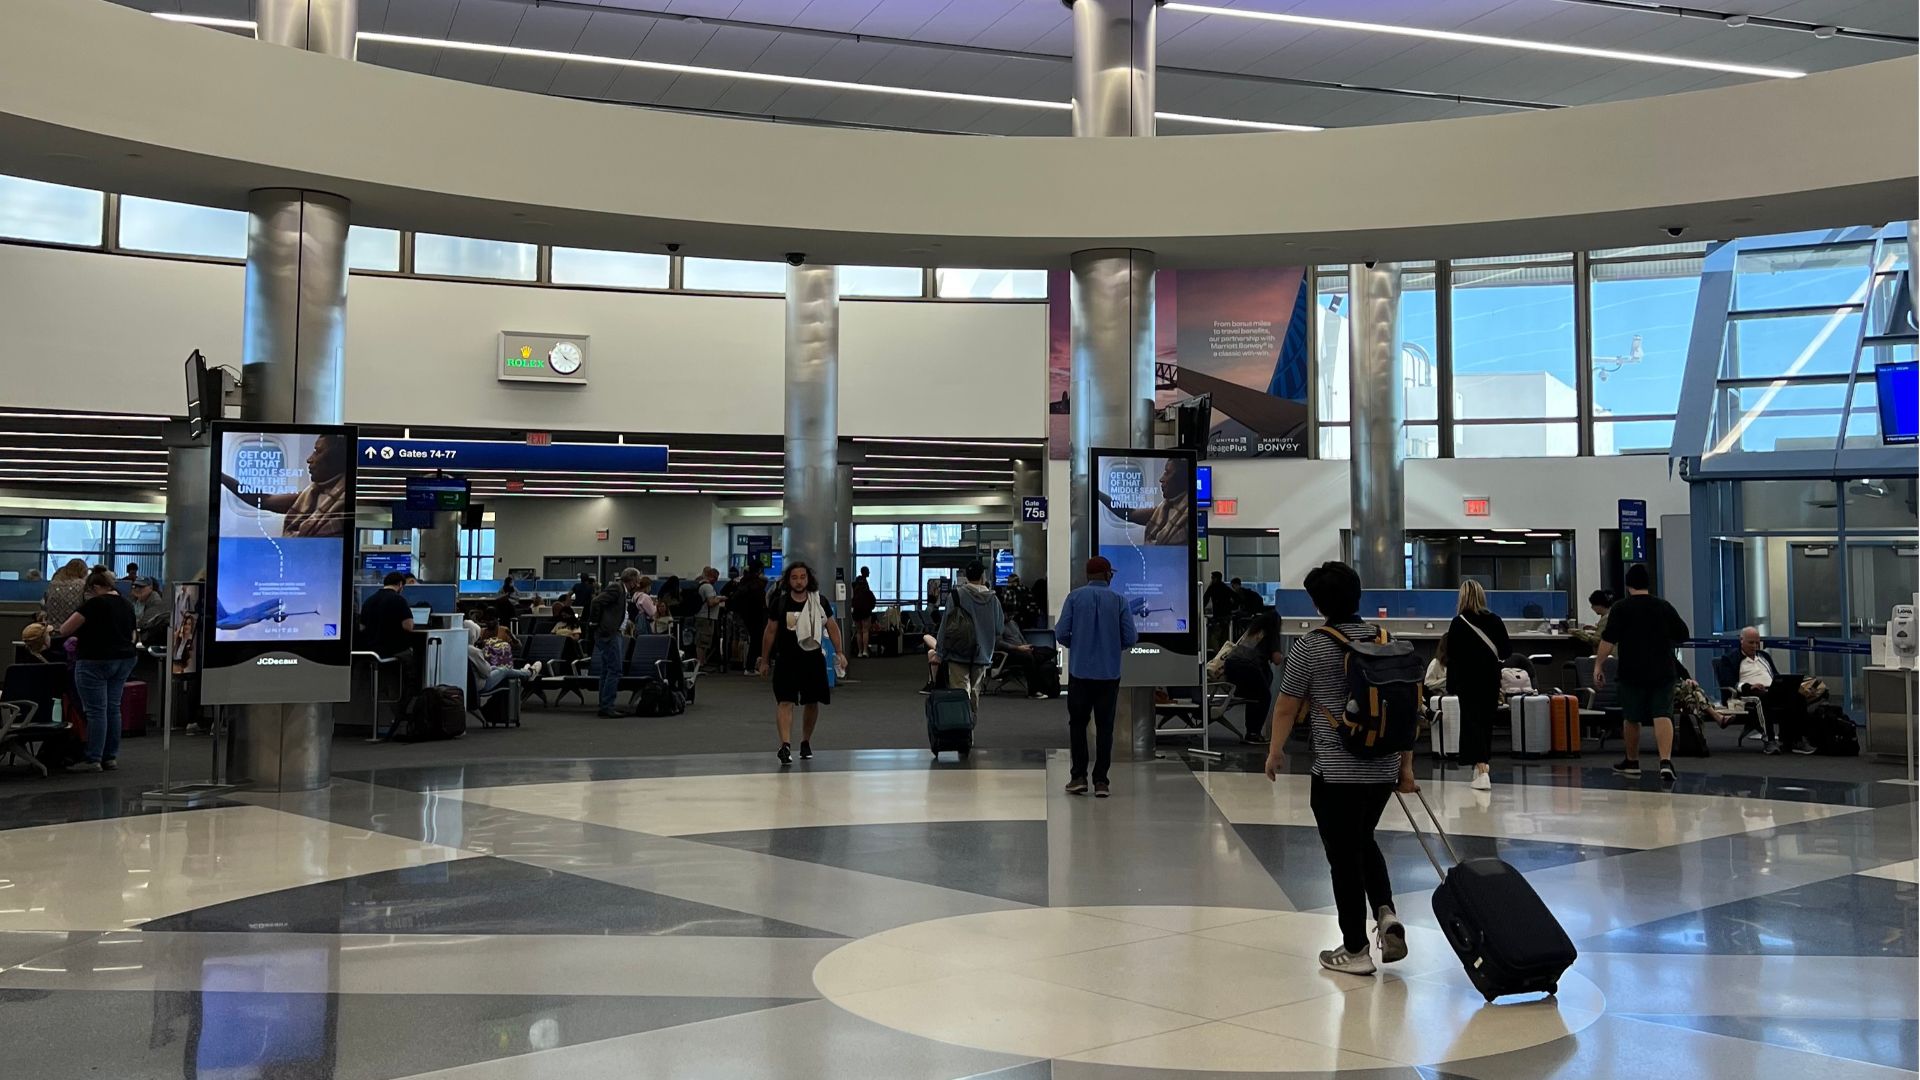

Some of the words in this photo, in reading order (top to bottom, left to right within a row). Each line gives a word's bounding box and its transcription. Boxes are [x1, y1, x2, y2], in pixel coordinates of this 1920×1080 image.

[1241, 328, 1270, 336] benefits,
[507, 358, 544, 368] ROLEX
[1258, 443, 1299, 452] BONVOY
[239, 450, 259, 459] GET
[260, 451, 282, 460] OUT
[399, 449, 427, 459] Gates
[430, 449, 457, 459] 74-77
[239, 460, 254, 468] OF
[255, 460, 280, 468] THAT
[239, 468, 277, 477] MIDDLE
[278, 468, 304, 477] SEAT
[238, 477, 262, 485] WITH
[264, 477, 287, 485] THE
[238, 485, 275, 494] UNITED
[1131, 494, 1146, 502] THE
[1467, 501, 1487, 513] EXIT
[1024, 508, 1045, 518] 75B
[1624, 536, 1630, 548] 2
[1636, 536, 1641, 548] 1
